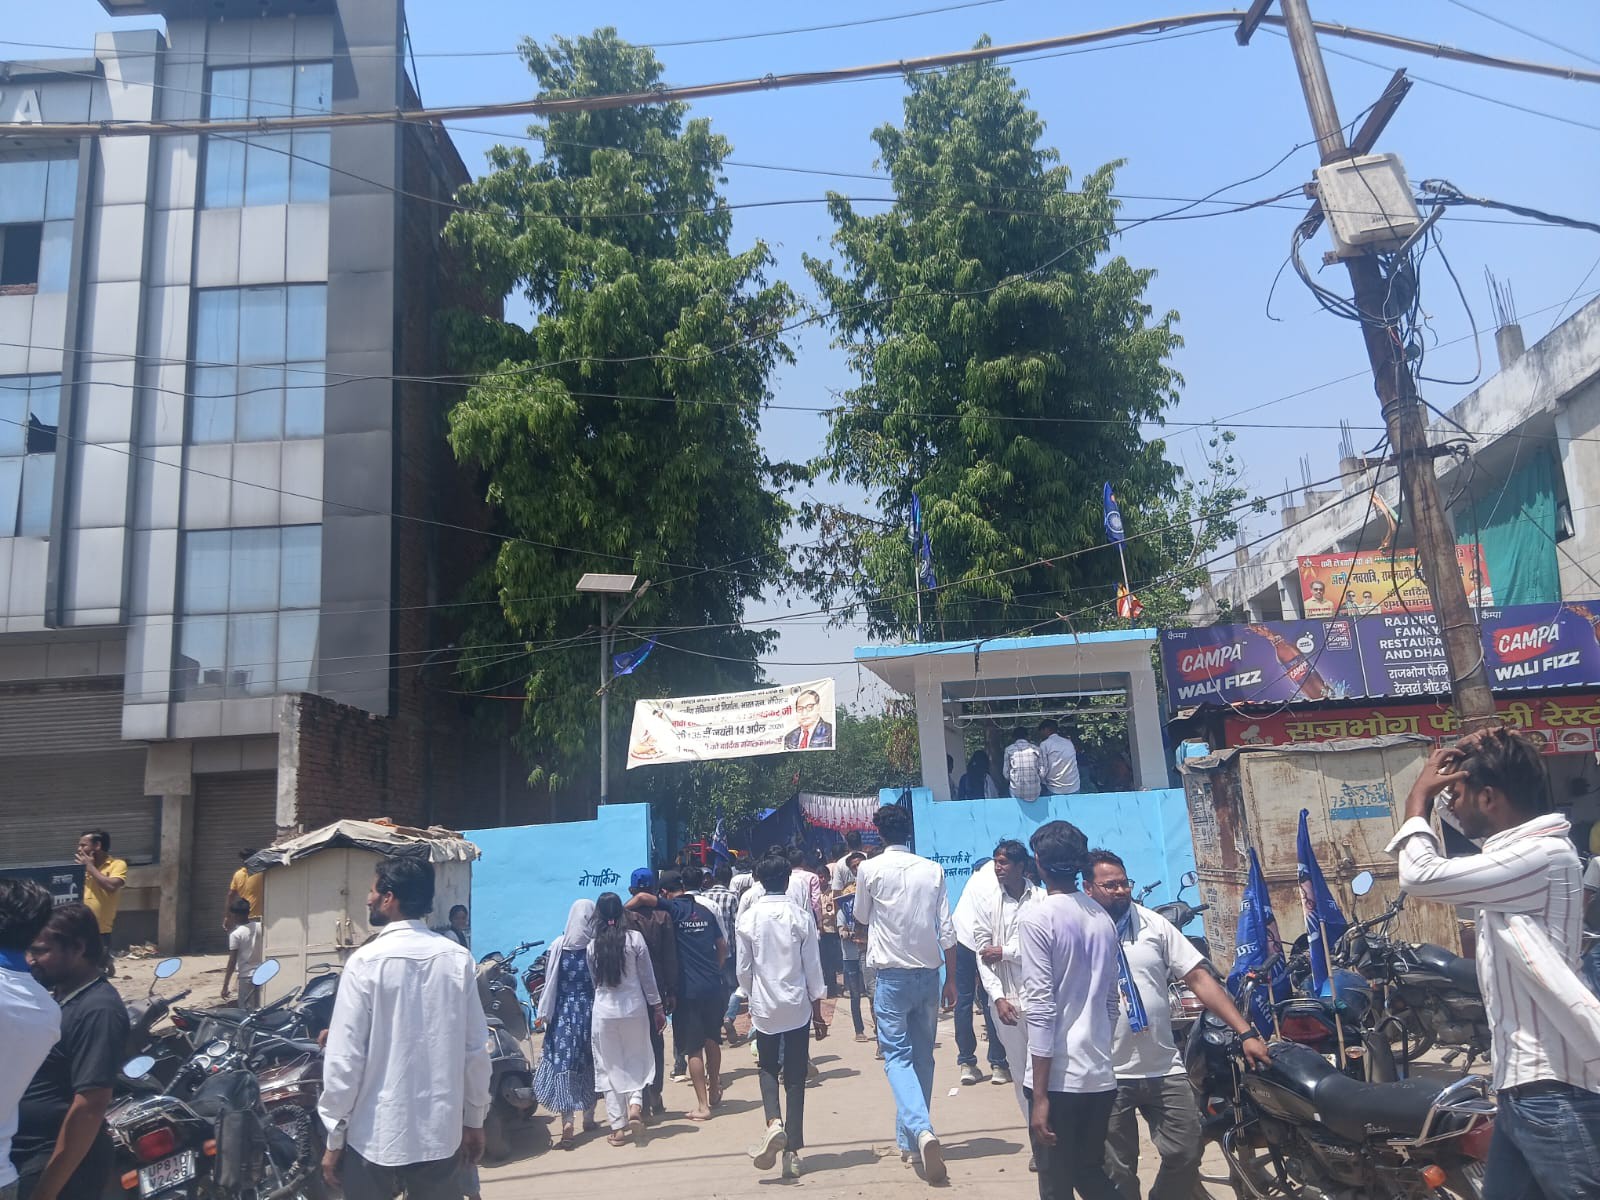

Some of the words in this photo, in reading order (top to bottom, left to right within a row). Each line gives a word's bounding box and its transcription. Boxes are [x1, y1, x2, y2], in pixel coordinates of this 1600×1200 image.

[1384, 617, 1408, 627] RAJ
[1411, 614, 1437, 625] BHO
[1480, 611, 1501, 620] कैम्पा
[1380, 637, 1443, 649] RESTAURA
[1499, 623, 1559, 653] CAMPA
[1181, 643, 1242, 673] CAMPA
[1385, 650, 1412, 660] AND
[1414, 647, 1445, 658] DHA
[1388, 666, 1426, 680] राजभोग
[1428, 663, 1449, 678] फैमि
[1495, 660, 1539, 681] WALI
[1543, 651, 1580, 672] FIZZ
[1178, 680, 1221, 700] WALI
[1225, 670, 1262, 690] FIZZ
[1422, 679, 1440, 692] और
[1440, 681, 1452, 692] ढा
[1284, 711, 1420, 741] राजभोग
[1428, 701, 1534, 732] फैली
[1543, 699, 1600, 727] रेस्ट
[736, 725, 745, 735] 14
[746, 721, 766, 735] अप्रैल
